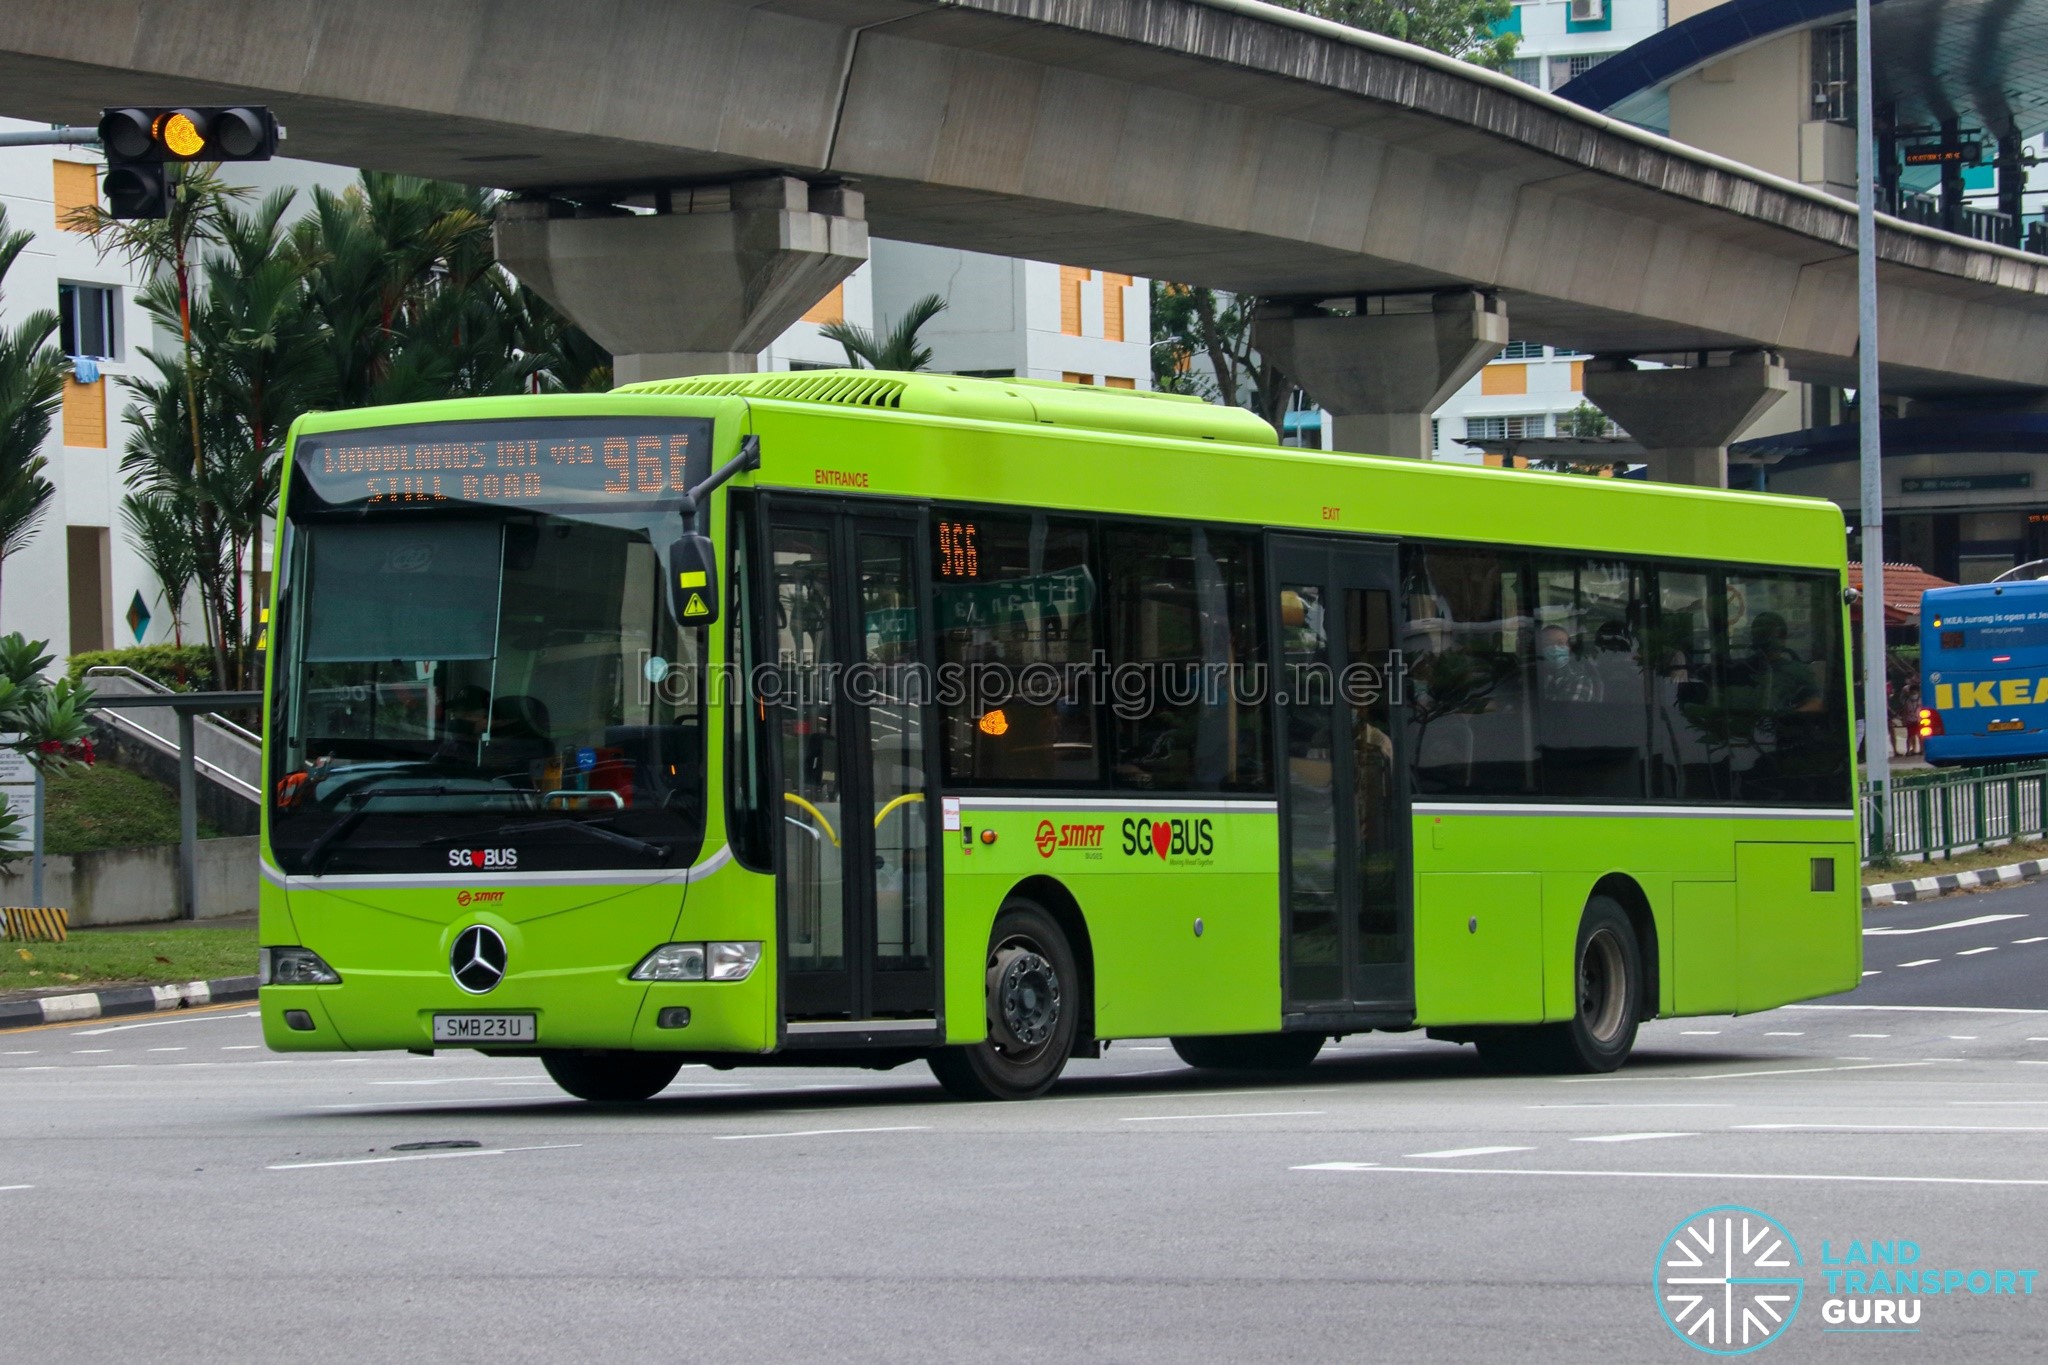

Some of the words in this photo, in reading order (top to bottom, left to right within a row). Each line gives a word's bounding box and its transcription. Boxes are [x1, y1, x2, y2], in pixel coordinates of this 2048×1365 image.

[323, 441, 486, 474] WOODLANDS
[496, 439, 540, 468] INT
[550, 438, 595, 467] via
[367, 475, 448, 504] STILL
[462, 472, 542, 500] ROAD
[815, 469, 869, 488] ENTRANCE
[1322, 506, 1340, 520] EXIT
[939, 521, 978, 577] 966
[1059, 824, 1105, 847] SMRT
[473, 891, 505, 902] SMRT
